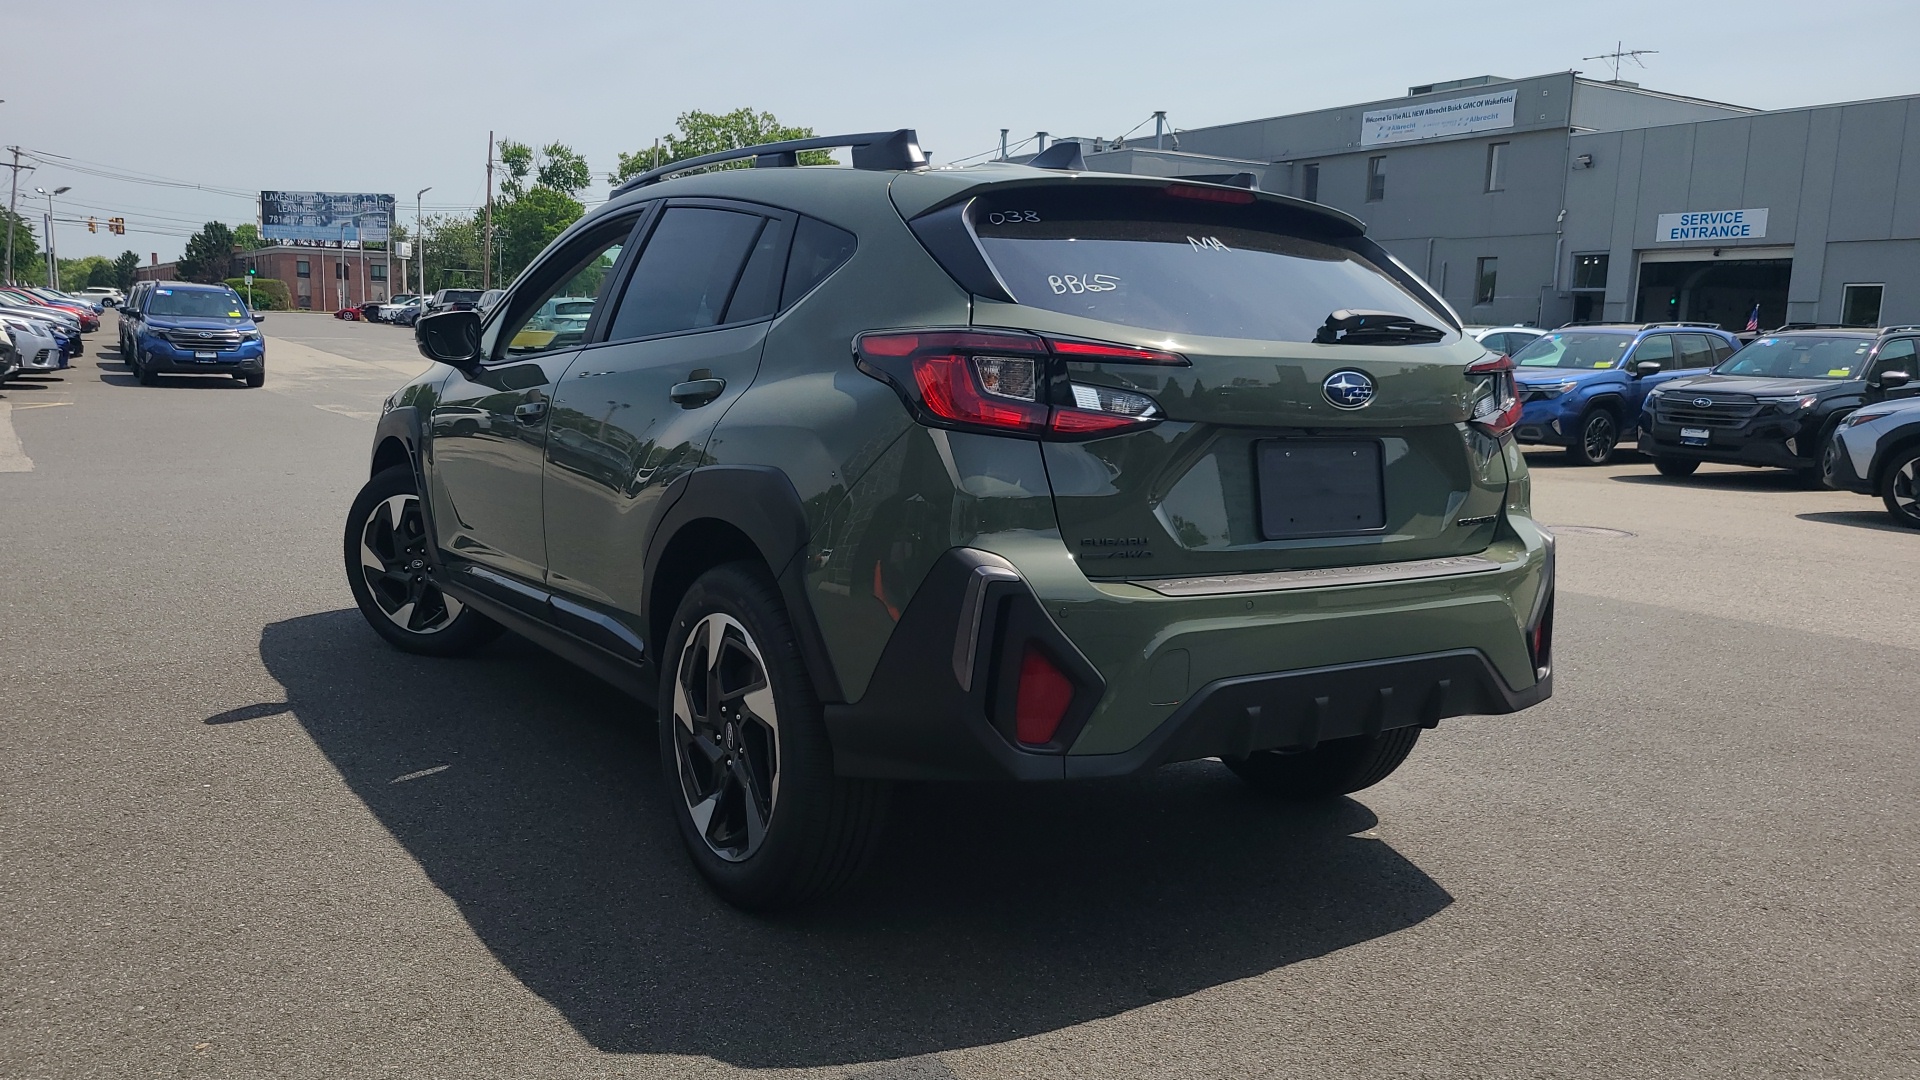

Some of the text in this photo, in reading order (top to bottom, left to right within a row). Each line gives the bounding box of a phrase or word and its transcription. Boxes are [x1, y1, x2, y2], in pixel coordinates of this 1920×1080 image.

[1365, 116, 1386, 124] Welcome
[1401, 111, 1412, 119] ALL
[1412, 109, 1424, 117] NEW
[1425, 106, 1447, 116] Albrecht
[1447, 103, 1462, 112] Buick
[1463, 101, 1476, 110] GMC
[1484, 96, 1513, 107] Wakefield
[1469, 112, 1499, 123] Albrecht
[1391, 122, 1416, 131] Albrecht
[989, 210, 1041, 225] 038
[1680, 211, 1744, 226] SERVICE
[1670, 224, 1751, 239] ENTRANCE
[1047, 273, 1121, 295] BB65
[1080, 537, 1149, 546] SUBARU
